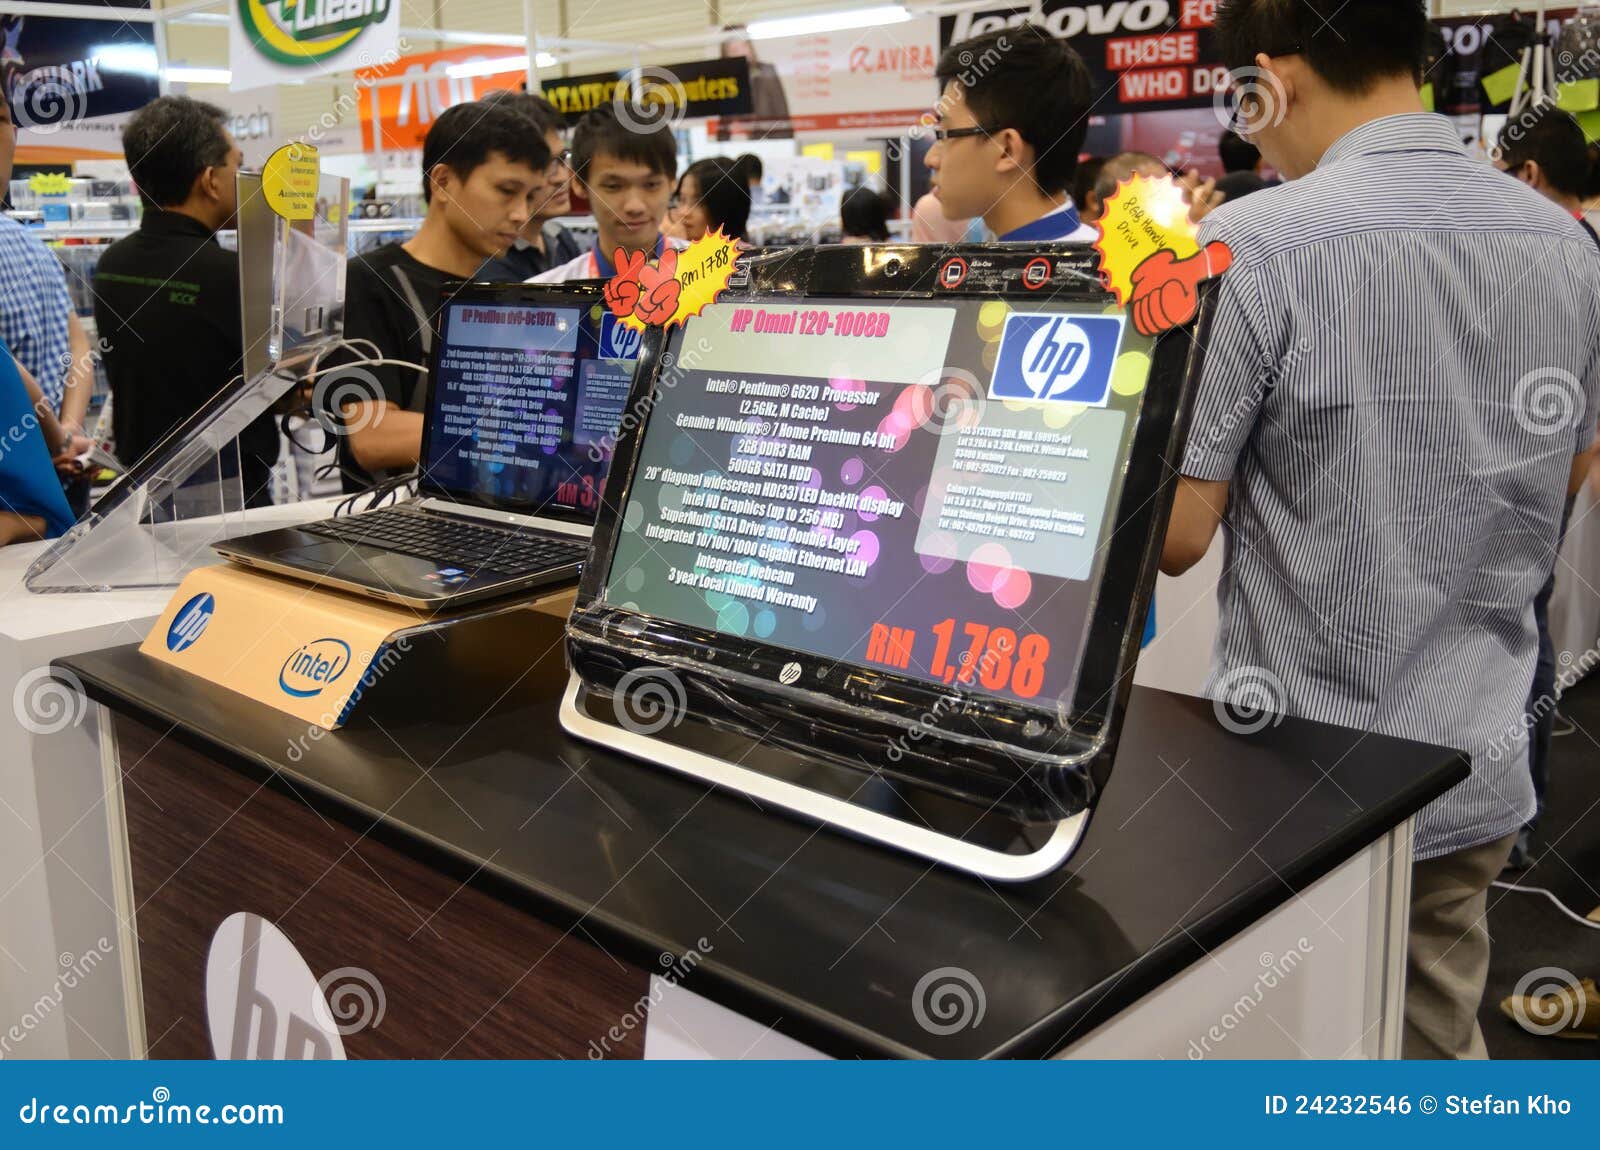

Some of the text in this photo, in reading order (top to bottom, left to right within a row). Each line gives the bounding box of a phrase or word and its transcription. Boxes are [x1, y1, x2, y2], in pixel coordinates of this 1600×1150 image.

[1184, 0, 1217, 25] FO
[876, 44, 935, 72] AVIRA
[1110, 36, 1194, 65] THOSE
[1123, 71, 1183, 99] WHO
[1117, 221, 1139, 249] Drive
[730, 309, 890, 338] HP Omni 120-1008D
[1026, 318, 1086, 399] hp
[738, 380, 790, 399] Pentium®
[790, 384, 819, 400] G620
[822, 385, 880, 405] Processor
[740, 400, 829, 422] (2.5GHz, M Cache)
[676, 413, 896, 450] Genuine Windows® 7 Home Premium 64 bit
[737, 440, 812, 461] 2GB DDR3 RAM
[728, 457, 812, 482] 500GB SATA HDD
[557, 480, 579, 504] RM
[662, 468, 703, 488] diagonal
[703, 475, 762, 496] widescreen
[799, 487, 819, 504] LED
[818, 489, 859, 510] backlit
[859, 495, 904, 518] display
[682, 490, 845, 529] Intel HD Graphics (up to 256 MB)
[661, 506, 860, 553] SuperMulti SATA Drive and Double Layer
[645, 523, 868, 577] Integrated 10/100/1000 Gigabit Ethernet LAN
[695, 552, 795, 585] Integrated webcam
[668, 567, 818, 613] 3 year Local Limited Warranty
[169, 593, 214, 652] hp
[291, 646, 343, 684] intel
[865, 618, 1050, 699] RM 1,788
